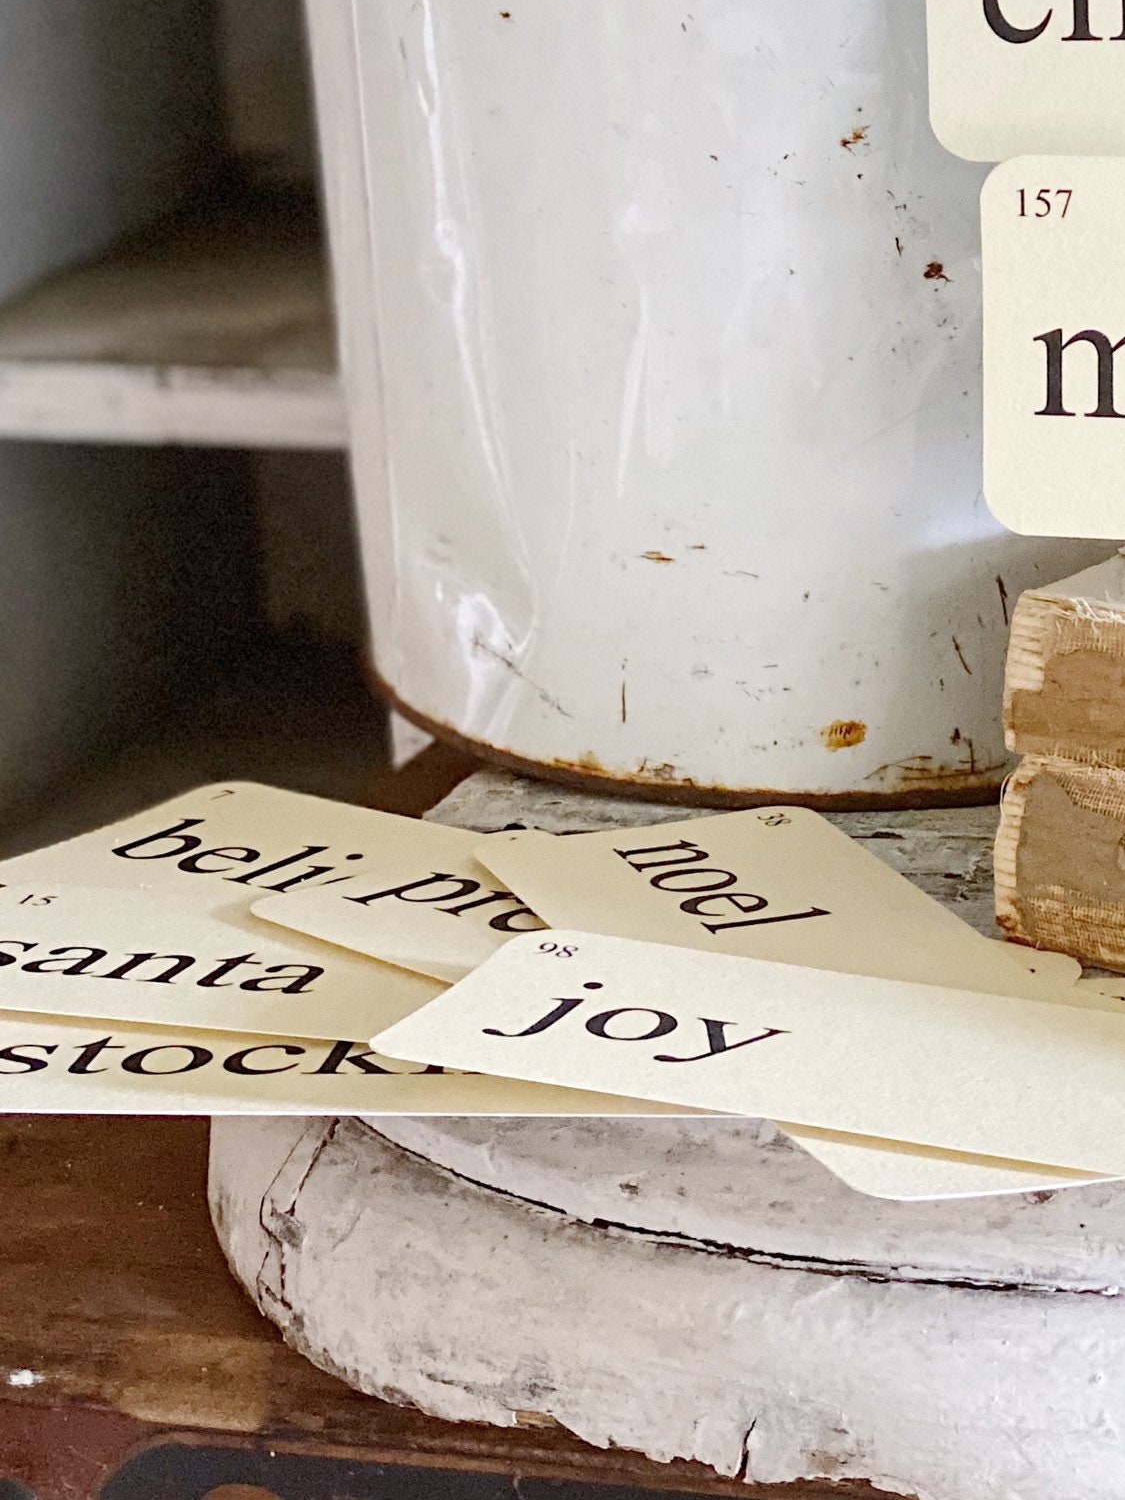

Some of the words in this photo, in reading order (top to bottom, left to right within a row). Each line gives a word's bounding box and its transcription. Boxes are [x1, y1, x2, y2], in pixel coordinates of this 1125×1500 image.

[1016, 188, 1073, 218] 157
[111, 818, 364, 893] beli
[19, 894, 58, 906] 15
[613, 839, 832, 935] noel
[0, 940, 325, 994] santa
[537, 941, 579, 959] 98
[482, 982, 791, 1062] joy
